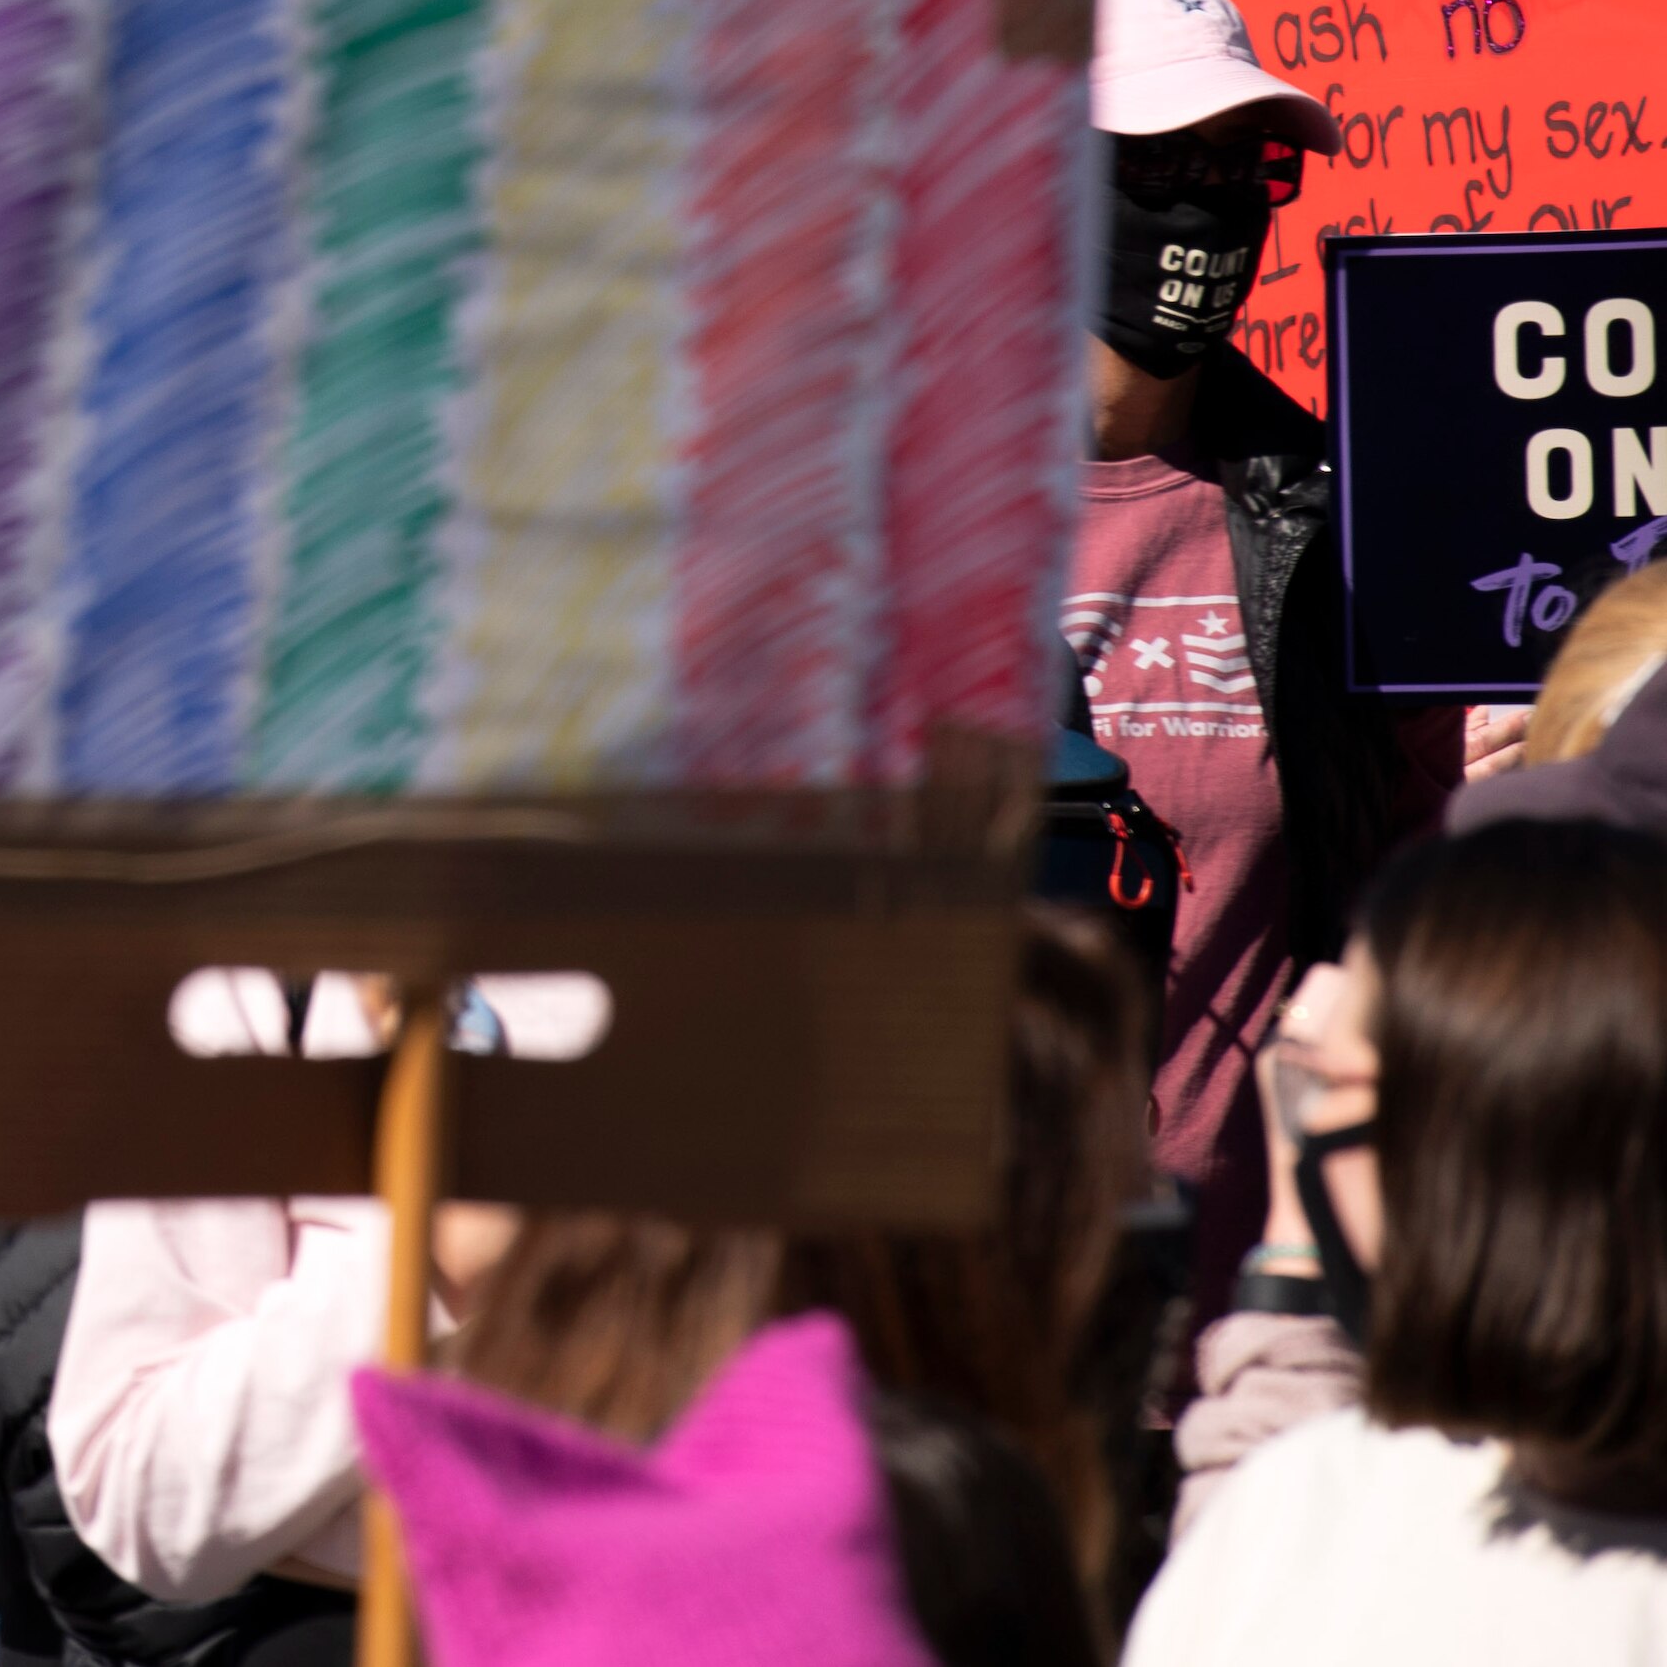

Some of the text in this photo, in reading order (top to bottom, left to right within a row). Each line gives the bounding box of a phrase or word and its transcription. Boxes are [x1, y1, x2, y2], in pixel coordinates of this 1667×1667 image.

[1324, 83, 1404, 170] for
[1423, 104, 1513, 200] my
[1159, 244, 1249, 279] COUNT
[1159, 280, 1238, 308] ON US
[1525, 425, 1667, 520] ON
[1470, 552, 1578, 647] to
[1119, 715, 1157, 738] for
